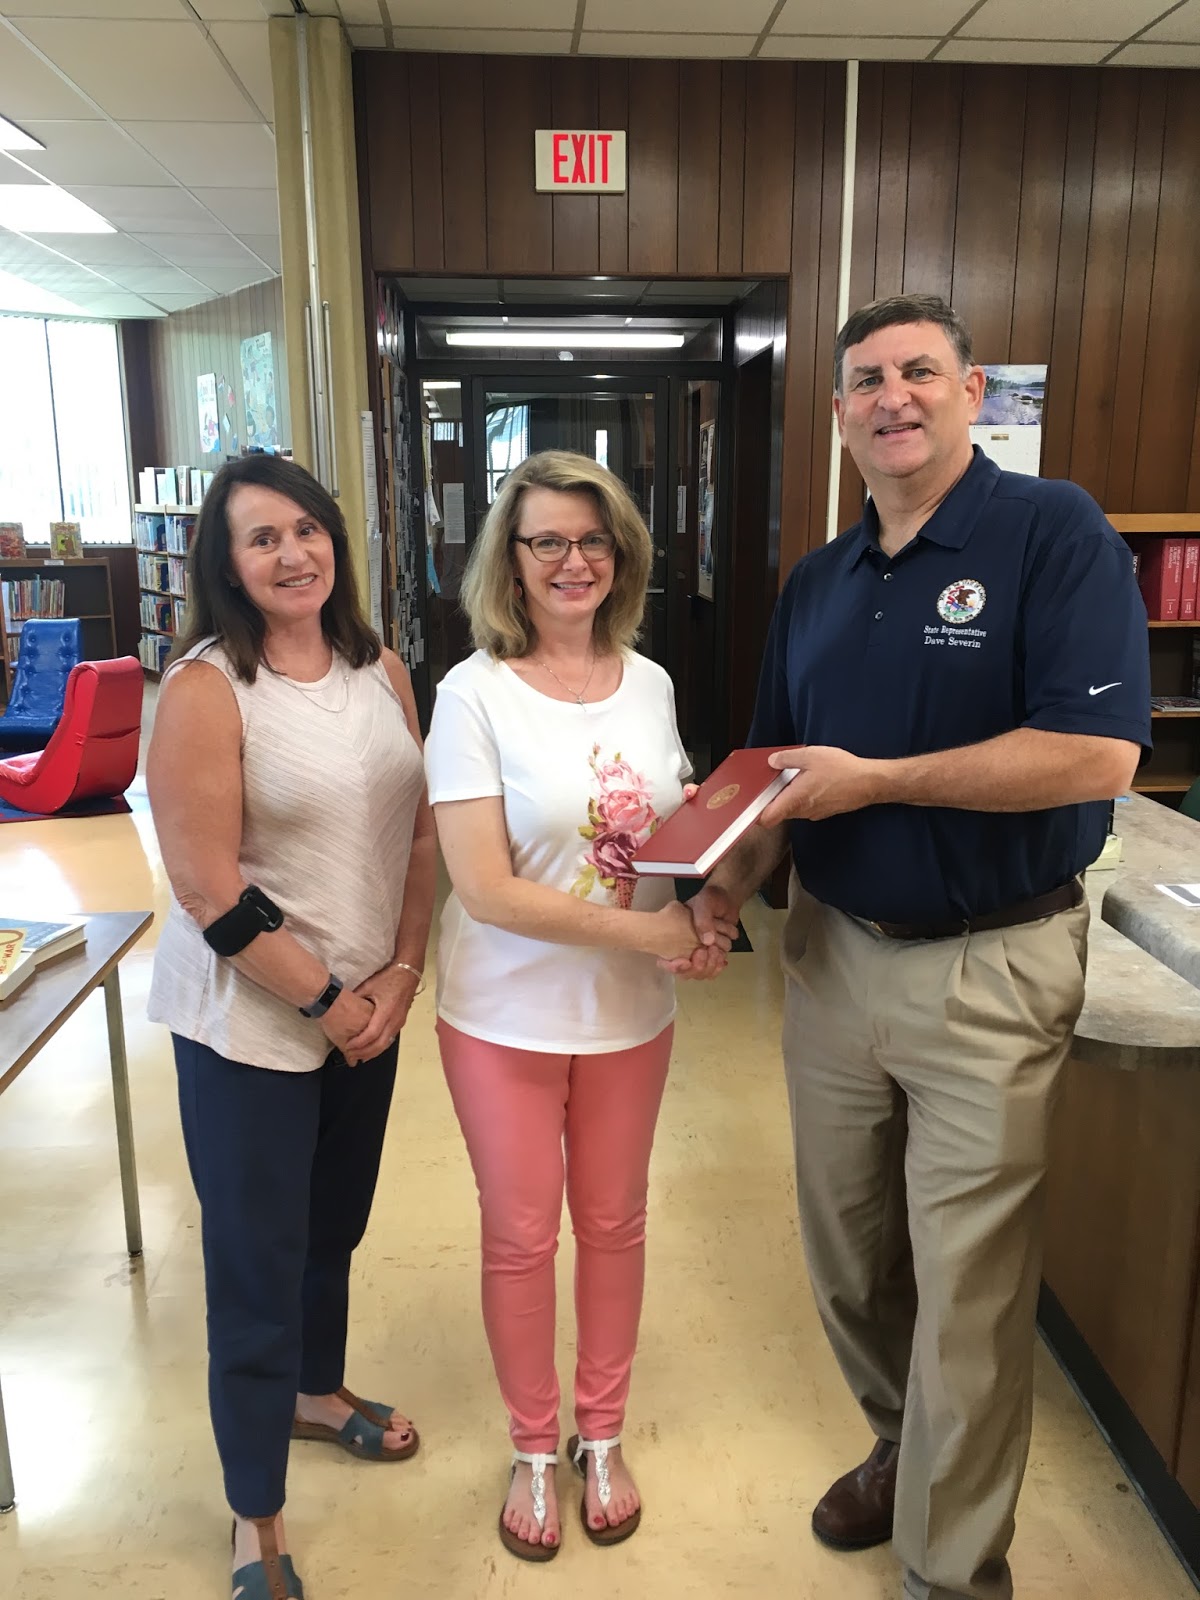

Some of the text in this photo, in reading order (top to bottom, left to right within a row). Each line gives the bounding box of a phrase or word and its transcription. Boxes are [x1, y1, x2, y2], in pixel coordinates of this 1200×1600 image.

[553, 134, 613, 183] EXIT
[923, 625, 987, 637] State Representative
[924, 636, 981, 648] Dave Severin
